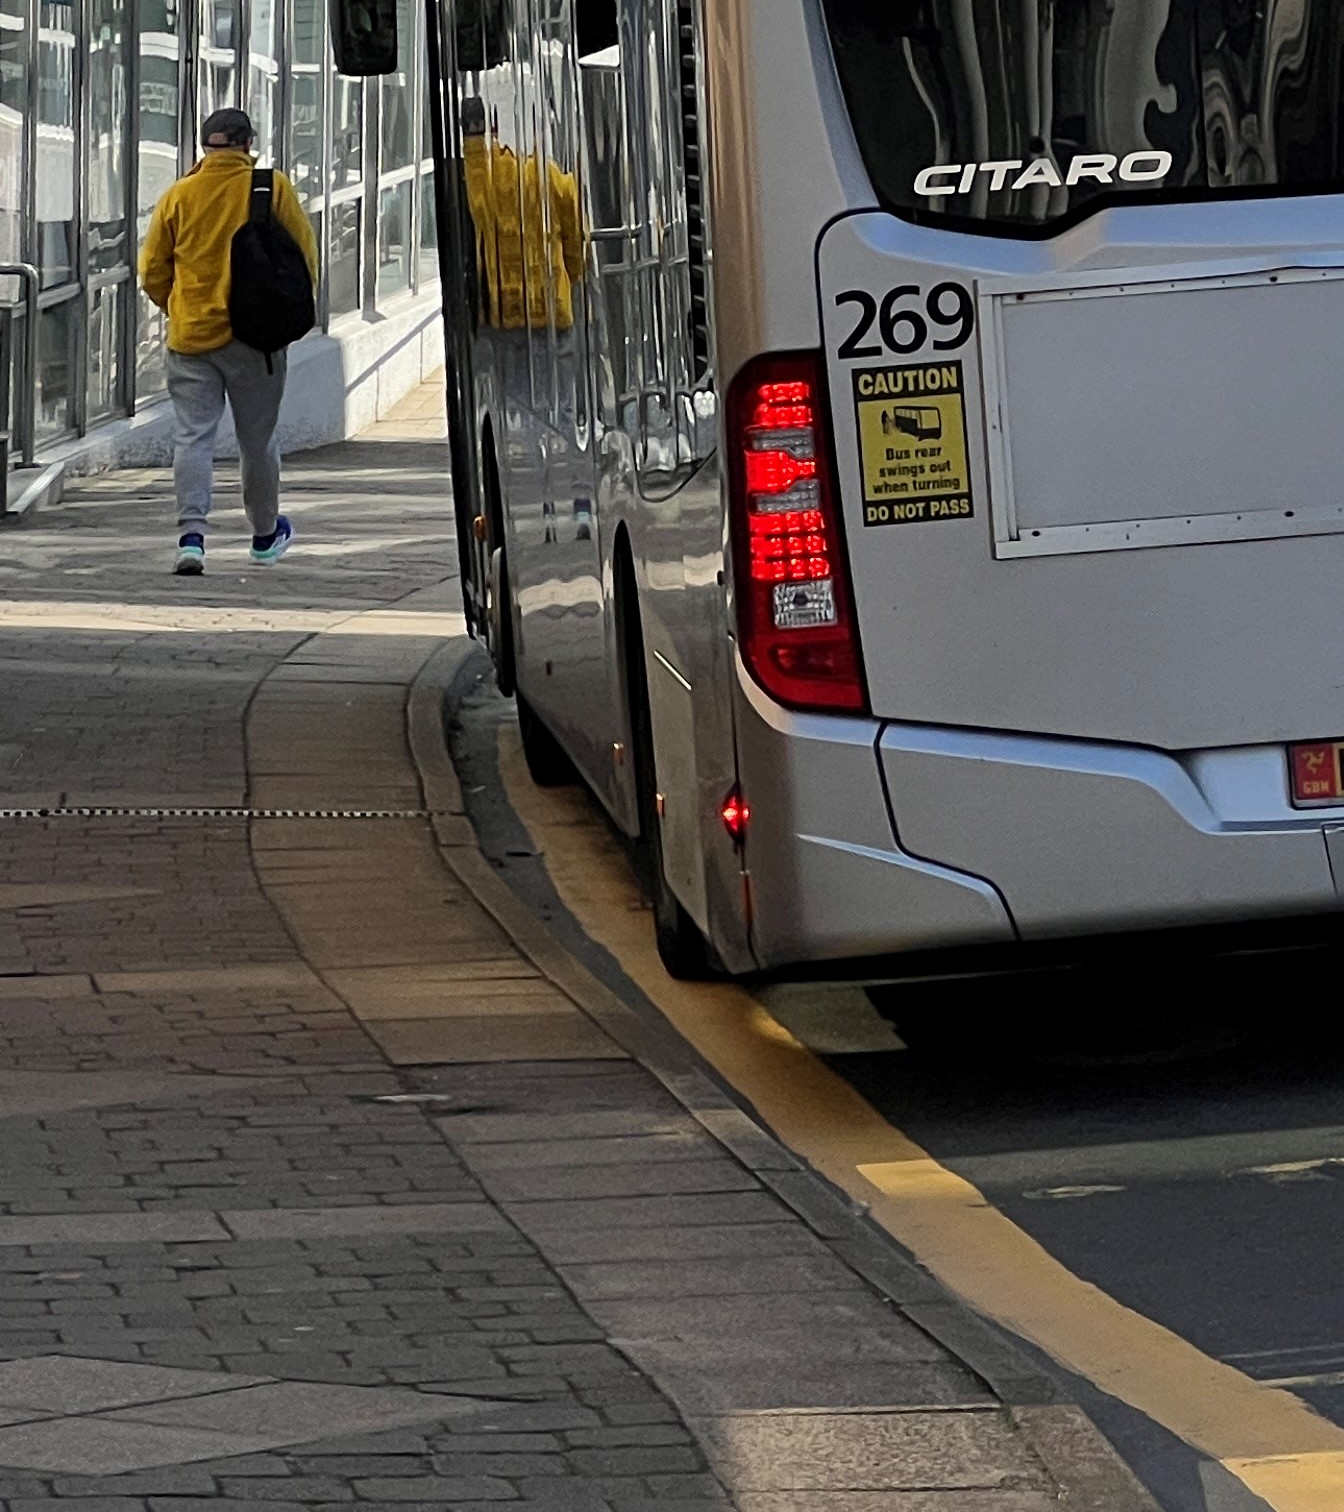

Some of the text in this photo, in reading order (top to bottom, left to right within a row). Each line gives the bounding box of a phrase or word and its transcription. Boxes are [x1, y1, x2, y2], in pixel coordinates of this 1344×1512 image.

[914, 150, 1172, 196] CITARO
[835, 282, 973, 359] 269
[858, 367, 957, 396] CAUTION
[885, 447, 941, 461] Bus rear
[879, 460, 951, 478] swings out
[872, 476, 960, 494] when turning
[867, 498, 970, 522] DO NOT PASS
